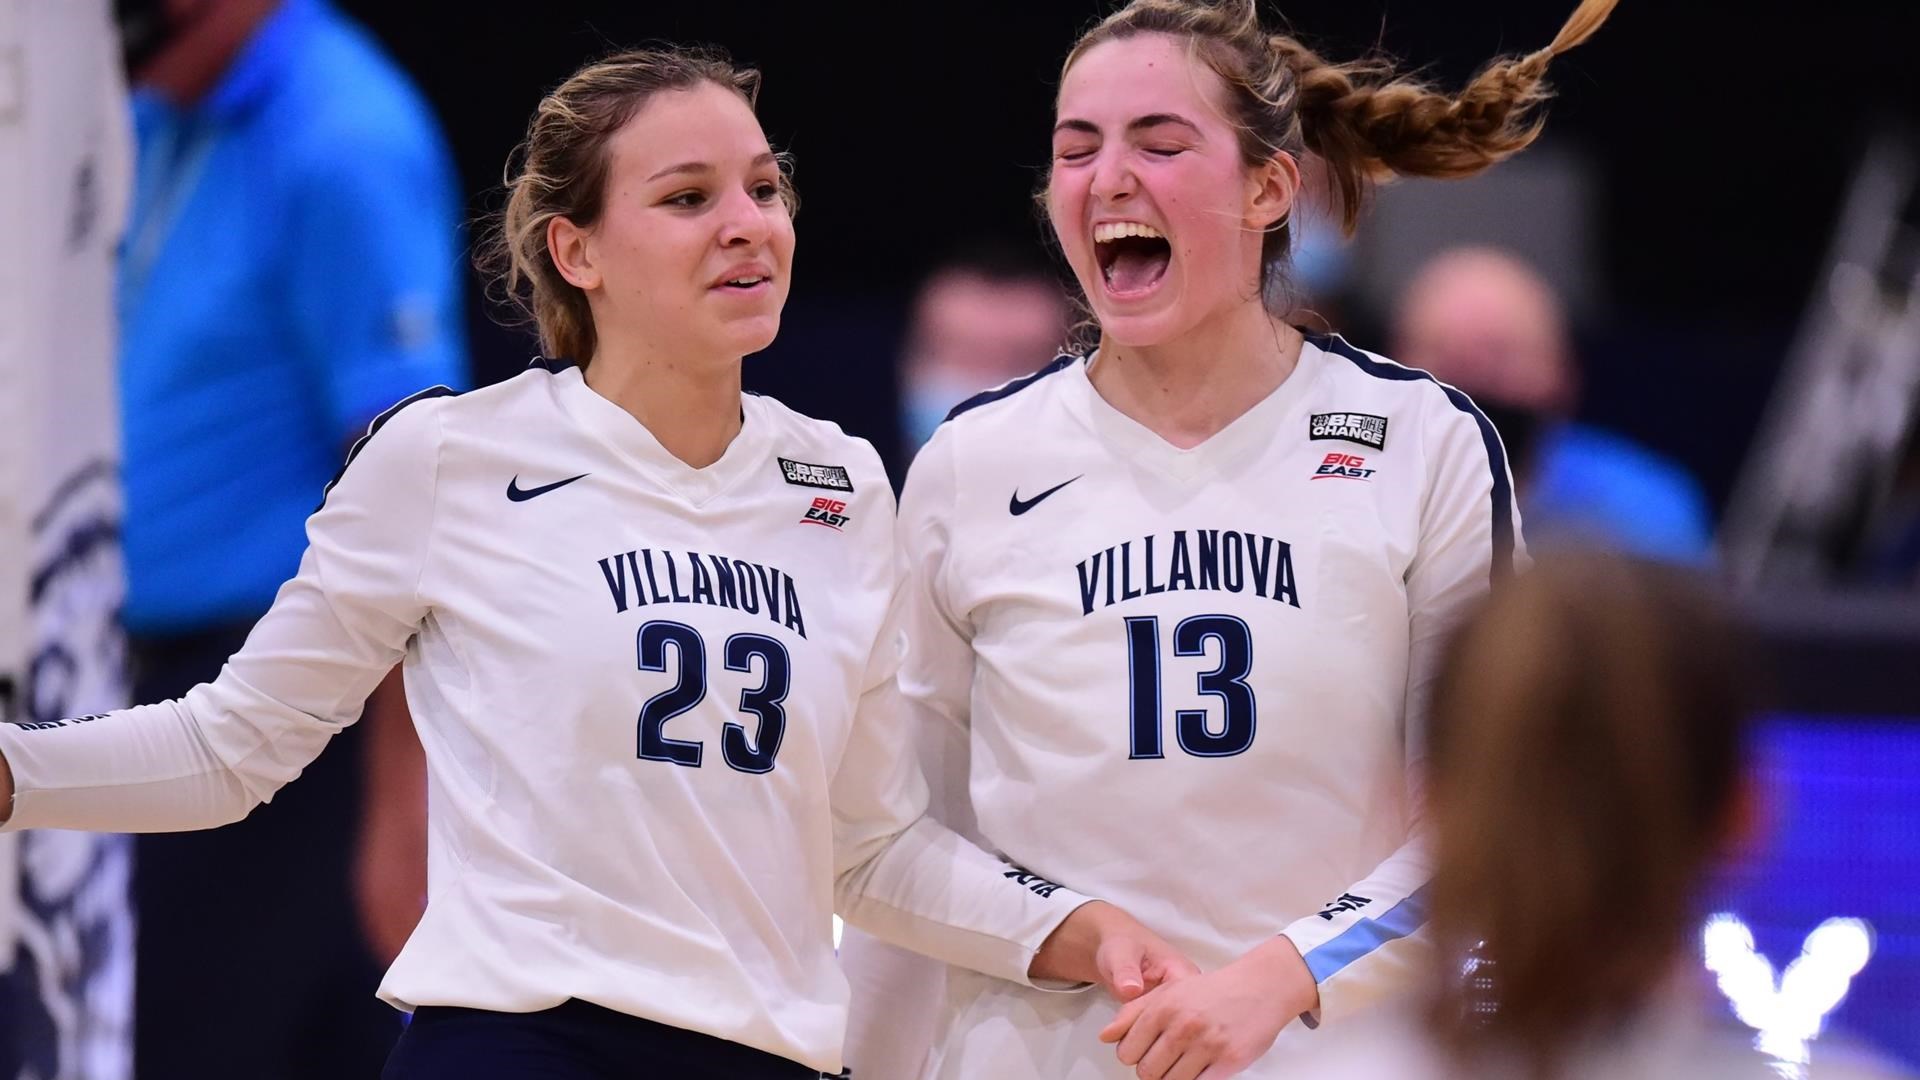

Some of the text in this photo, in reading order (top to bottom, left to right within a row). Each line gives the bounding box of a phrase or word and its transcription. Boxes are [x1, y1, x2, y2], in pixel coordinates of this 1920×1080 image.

[1312, 426, 1384, 445] CHANGE
[1322, 453, 1365, 467] BIG
[787, 472, 849, 488] CHANGE
[1315, 464, 1376, 478] EAST
[811, 497, 847, 514] BIG
[804, 507, 850, 527] EAST
[1075, 529, 1302, 617] VILLANOVA
[597, 548, 808, 641] VILLANOVA
[1122, 613, 1257, 760] 13
[636, 619, 792, 775] 23
